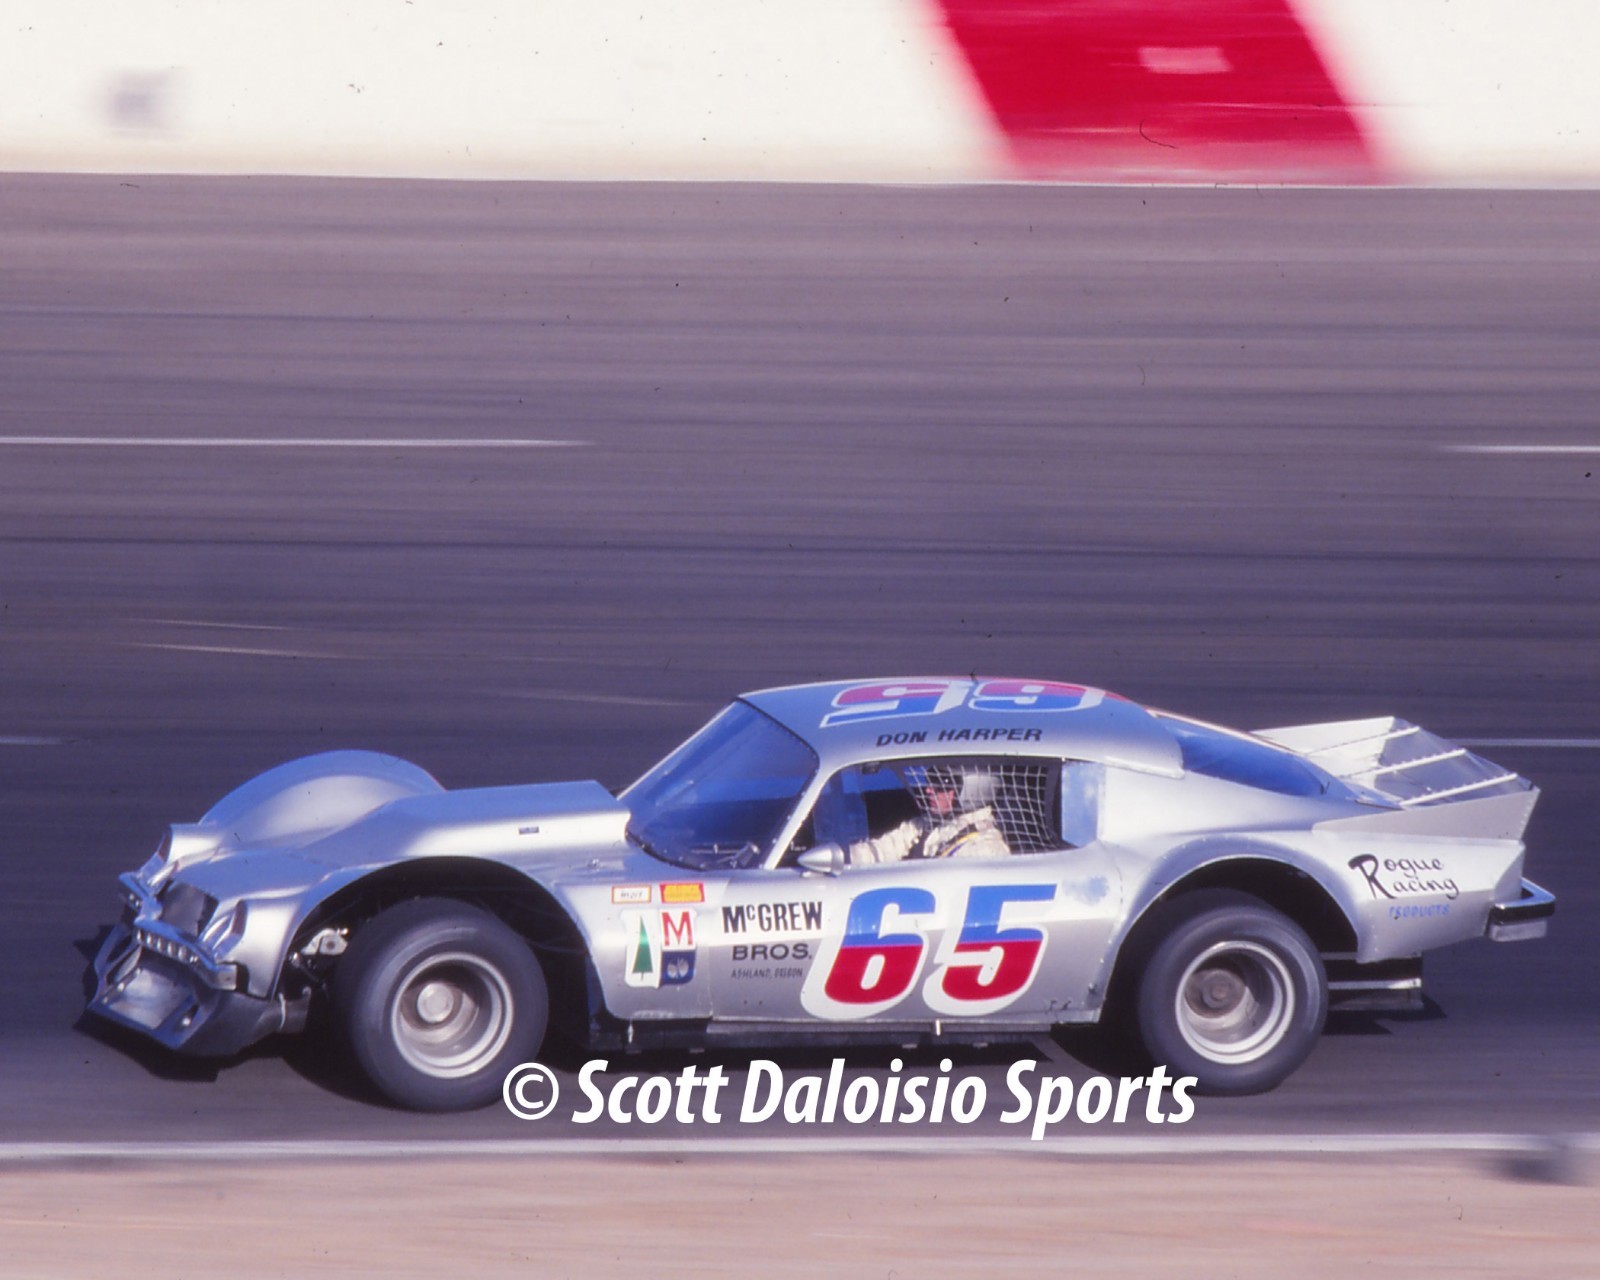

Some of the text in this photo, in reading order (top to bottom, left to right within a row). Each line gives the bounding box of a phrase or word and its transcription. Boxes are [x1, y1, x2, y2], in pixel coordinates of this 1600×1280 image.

[876, 728, 1043, 747] DON HARPER
[661, 911, 693, 947] M
[732, 943, 812, 961] BROS.
[824, 883, 1058, 1005] 65
